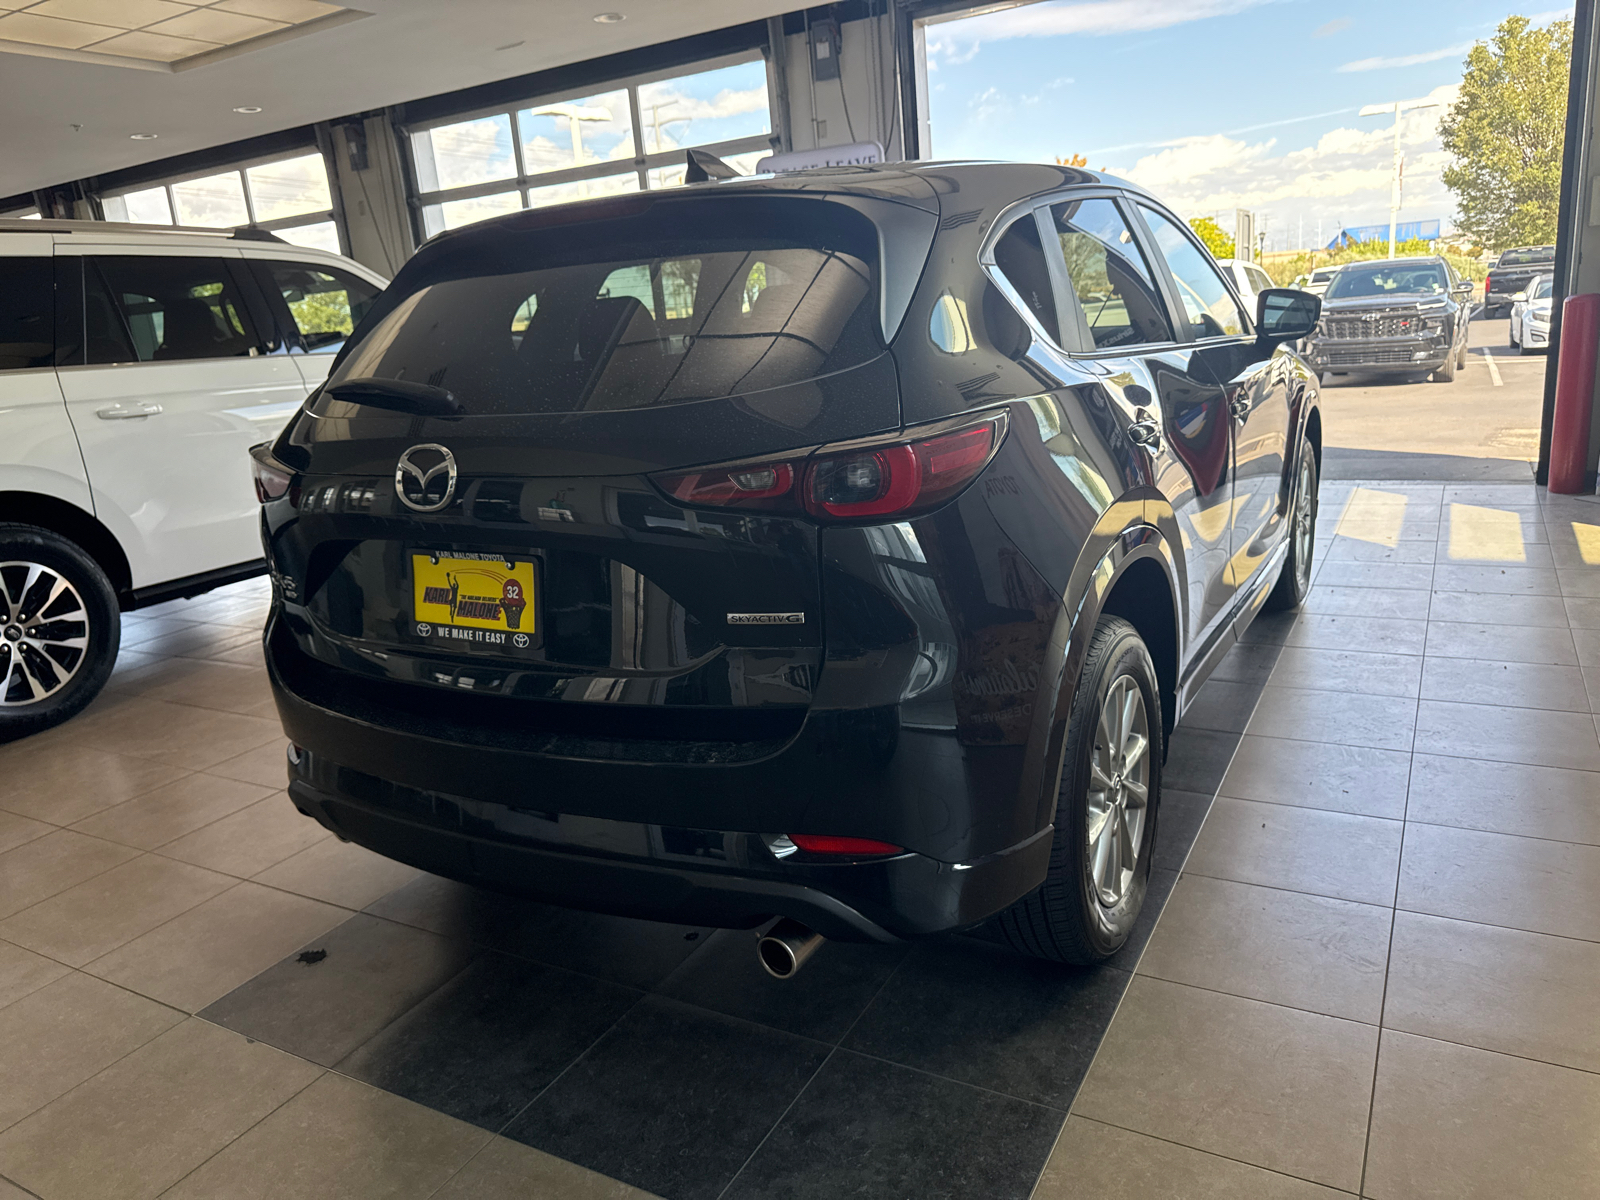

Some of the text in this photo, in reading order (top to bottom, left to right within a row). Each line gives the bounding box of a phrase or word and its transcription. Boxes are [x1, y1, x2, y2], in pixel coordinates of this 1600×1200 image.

[435, 550, 505, 562] KARL MALONE TOYOTA
[423, 586, 452, 605] KARL
[506, 586, 519, 599] 32
[456, 600, 502, 621] MALONE
[437, 626, 506, 644] WE MAKE IT EASY
